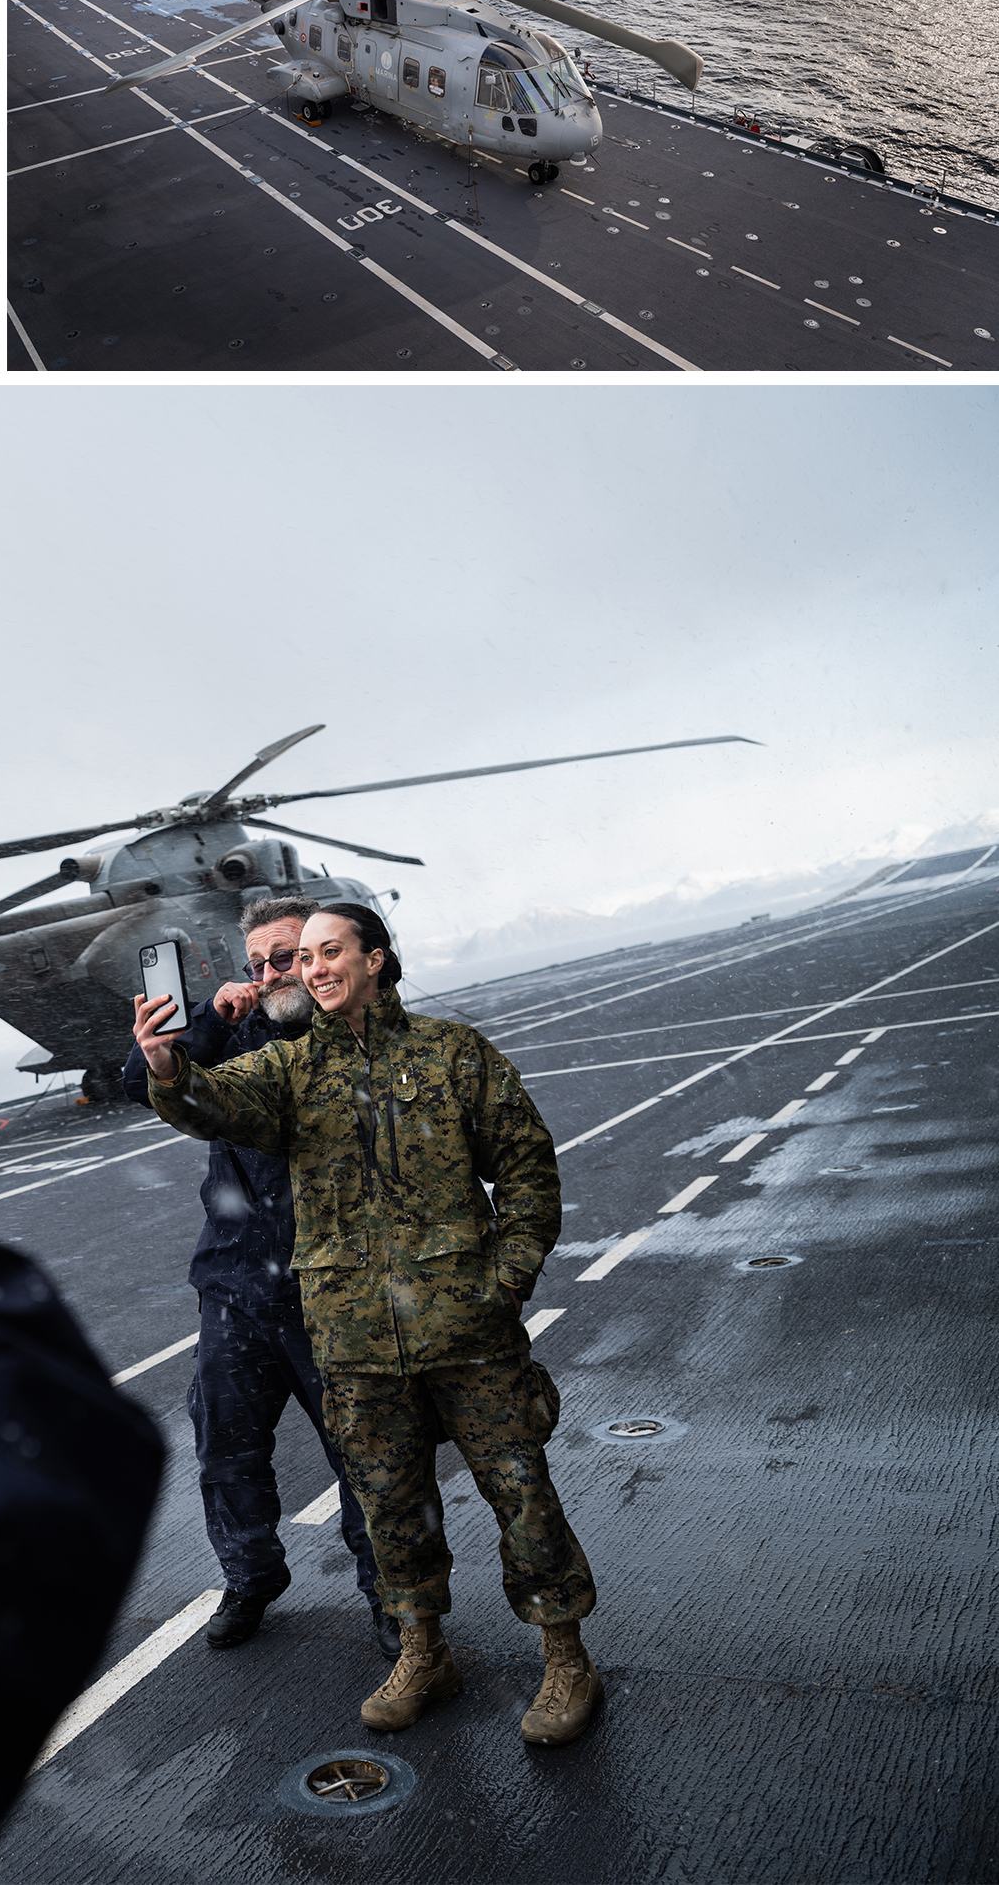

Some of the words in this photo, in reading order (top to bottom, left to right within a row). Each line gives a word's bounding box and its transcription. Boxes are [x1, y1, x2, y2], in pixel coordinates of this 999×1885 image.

[104, 46, 151, 60] 350
[375, 66, 398, 82] MARINA
[590, 134, 600, 147] 15
[336, 199, 403, 231] 300
